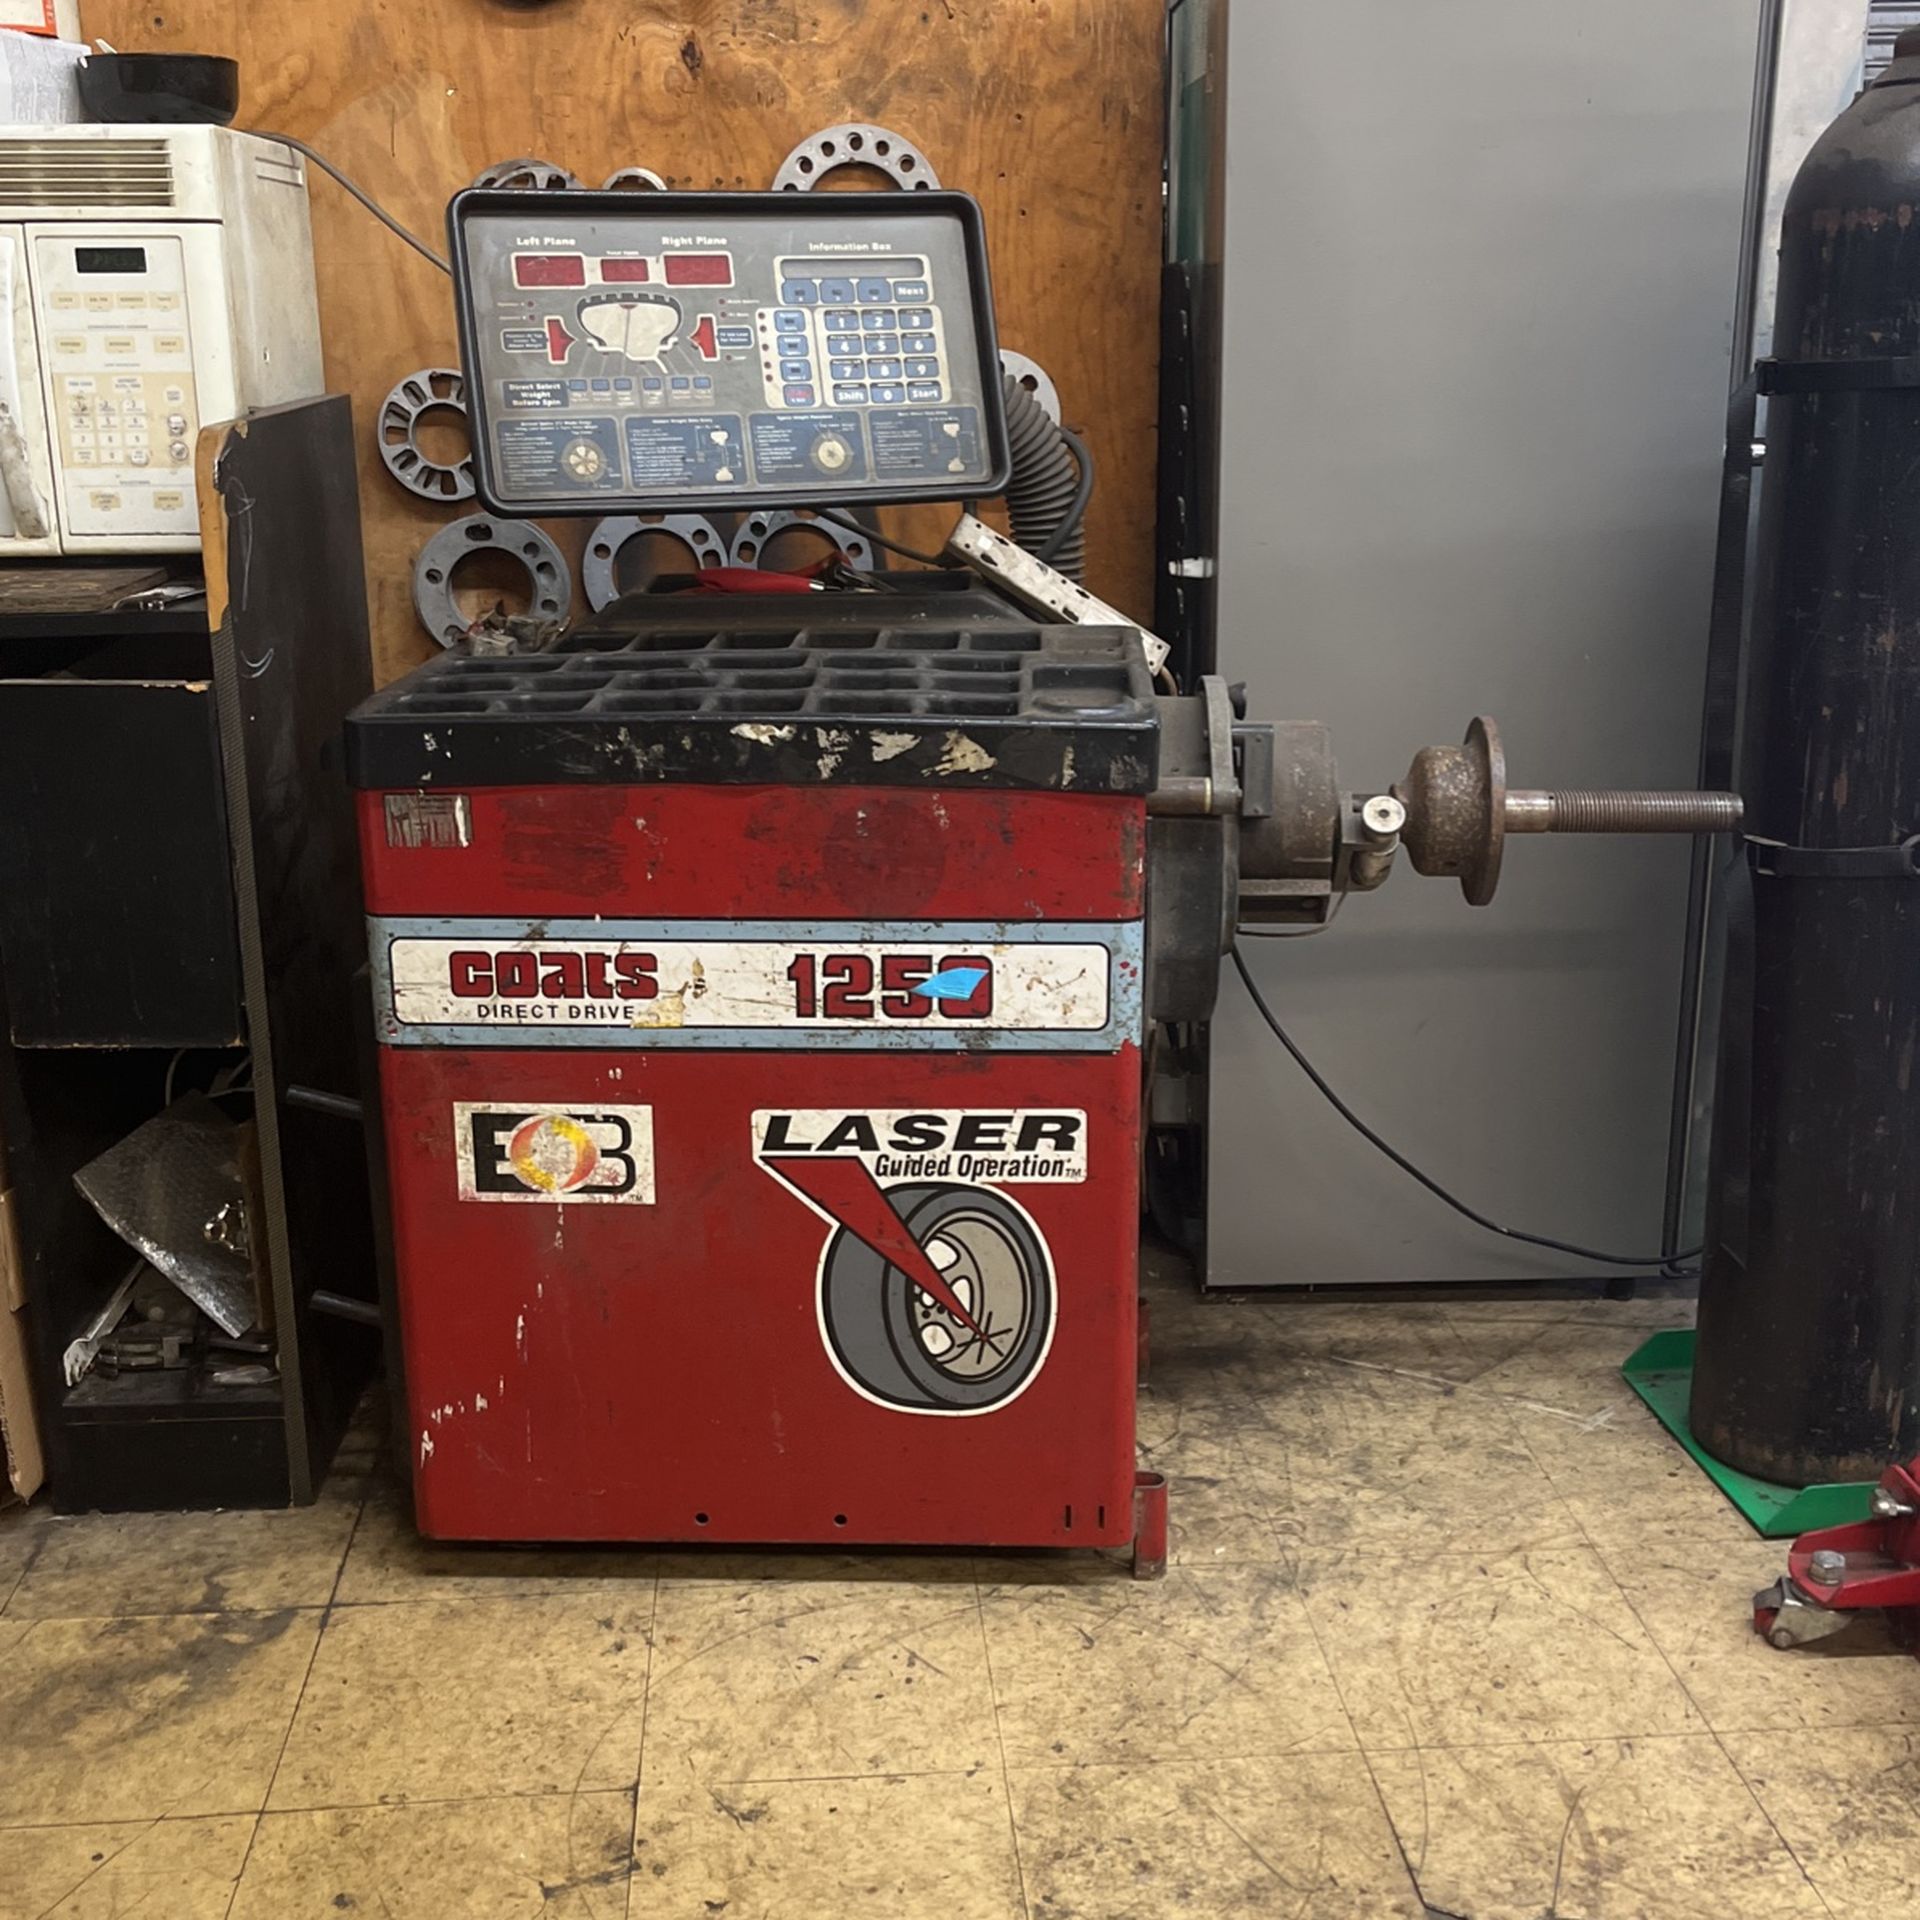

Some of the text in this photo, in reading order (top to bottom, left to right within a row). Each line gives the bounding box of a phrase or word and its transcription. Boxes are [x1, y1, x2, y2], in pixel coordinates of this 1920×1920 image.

[516, 236, 577, 246] Left Plane
[661, 236, 728, 247] Right Plane
[809, 242, 892, 251] Information Box
[898, 287, 924, 296] Next
[838, 317, 845, 328] 1
[874, 316, 884, 328] 2
[840, 341, 850, 352] 4
[877, 340, 887, 352] 5
[914, 340, 924, 351] 6
[842, 367, 852, 378] 7
[917, 364, 927, 376] 9
[508, 382, 561, 391] Direct Select
[838, 392, 864, 401] Shift
[912, 389, 938, 398] Start
[478, 1004, 635, 1019] DIRECT DRIVE
[762, 1114, 1082, 1152] LASER
[875, 1153, 951, 1178] Guided
[957, 1154, 1065, 1182] Operation
